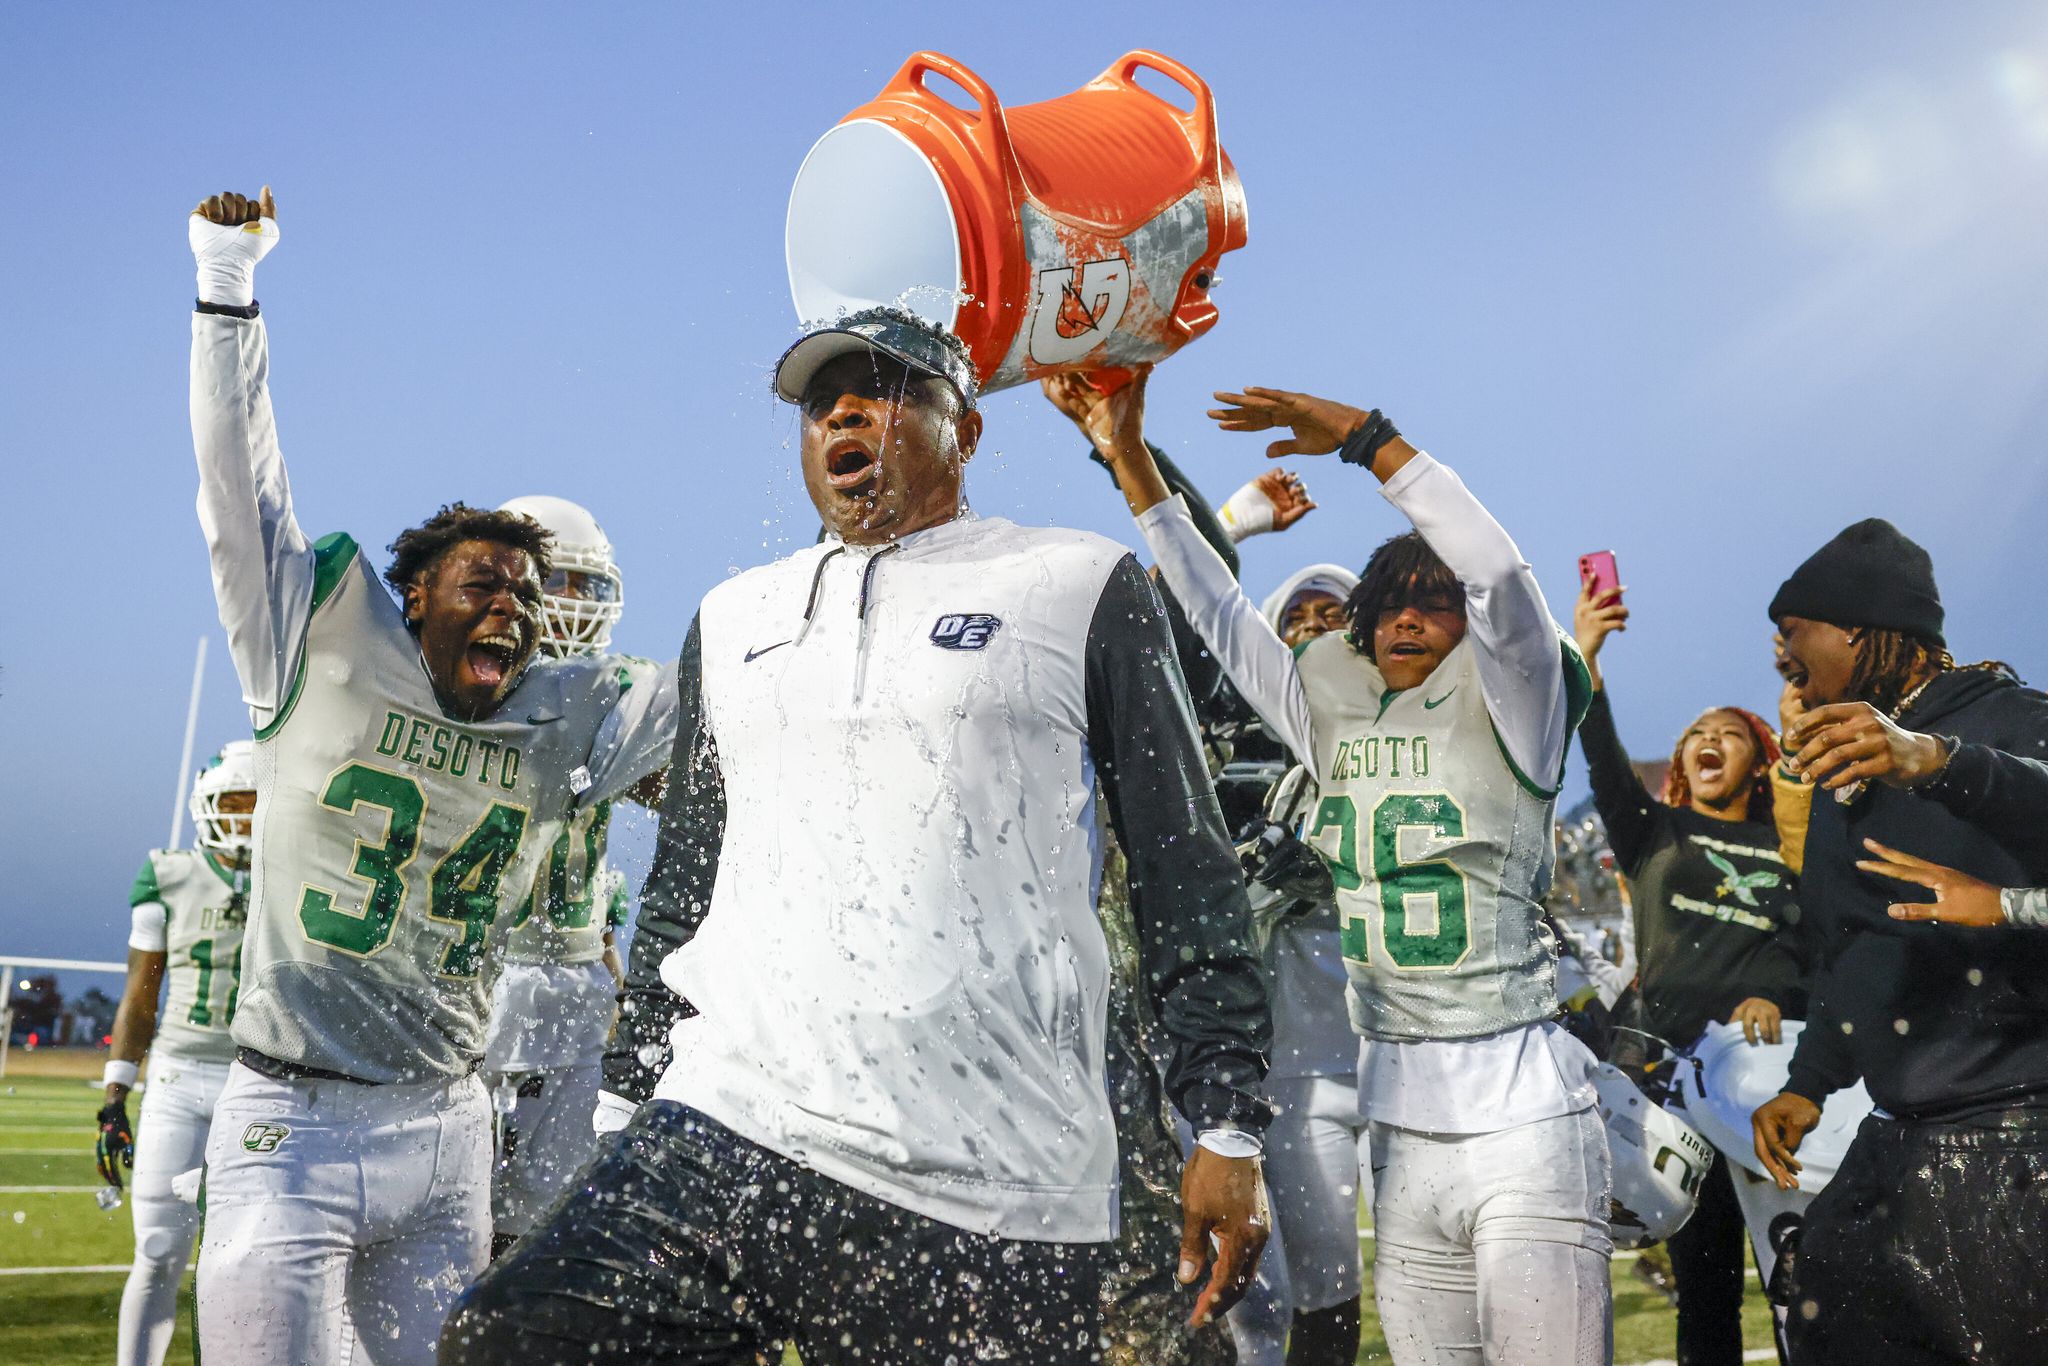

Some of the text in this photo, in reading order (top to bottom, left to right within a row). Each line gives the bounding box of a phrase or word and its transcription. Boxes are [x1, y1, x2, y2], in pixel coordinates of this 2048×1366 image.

[375, 710, 522, 791] DESOTO
[295, 758, 531, 981] 34
[1309, 789, 1475, 972] 26
